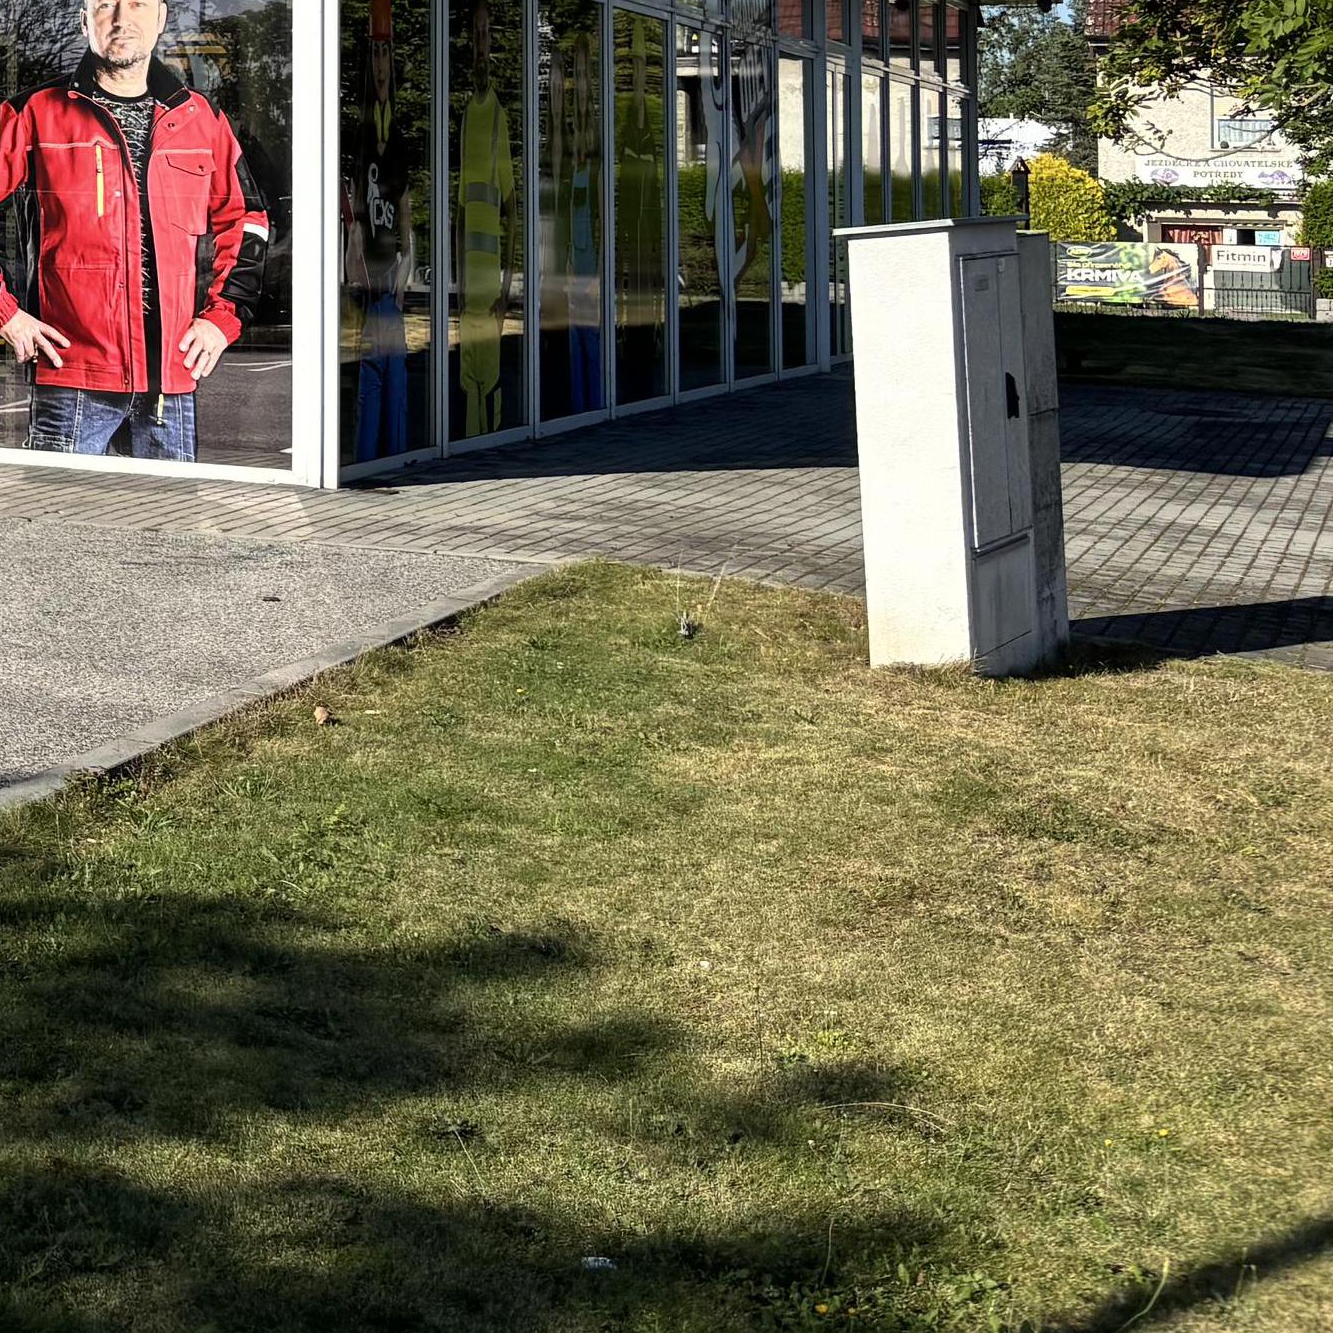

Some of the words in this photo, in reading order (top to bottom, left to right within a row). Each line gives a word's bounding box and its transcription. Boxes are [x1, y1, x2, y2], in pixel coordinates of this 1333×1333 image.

[374, 198, 395, 230] CXS
[1216, 249, 1267, 263] Fitmin
[1066, 268, 1144, 283] KRMIVA
